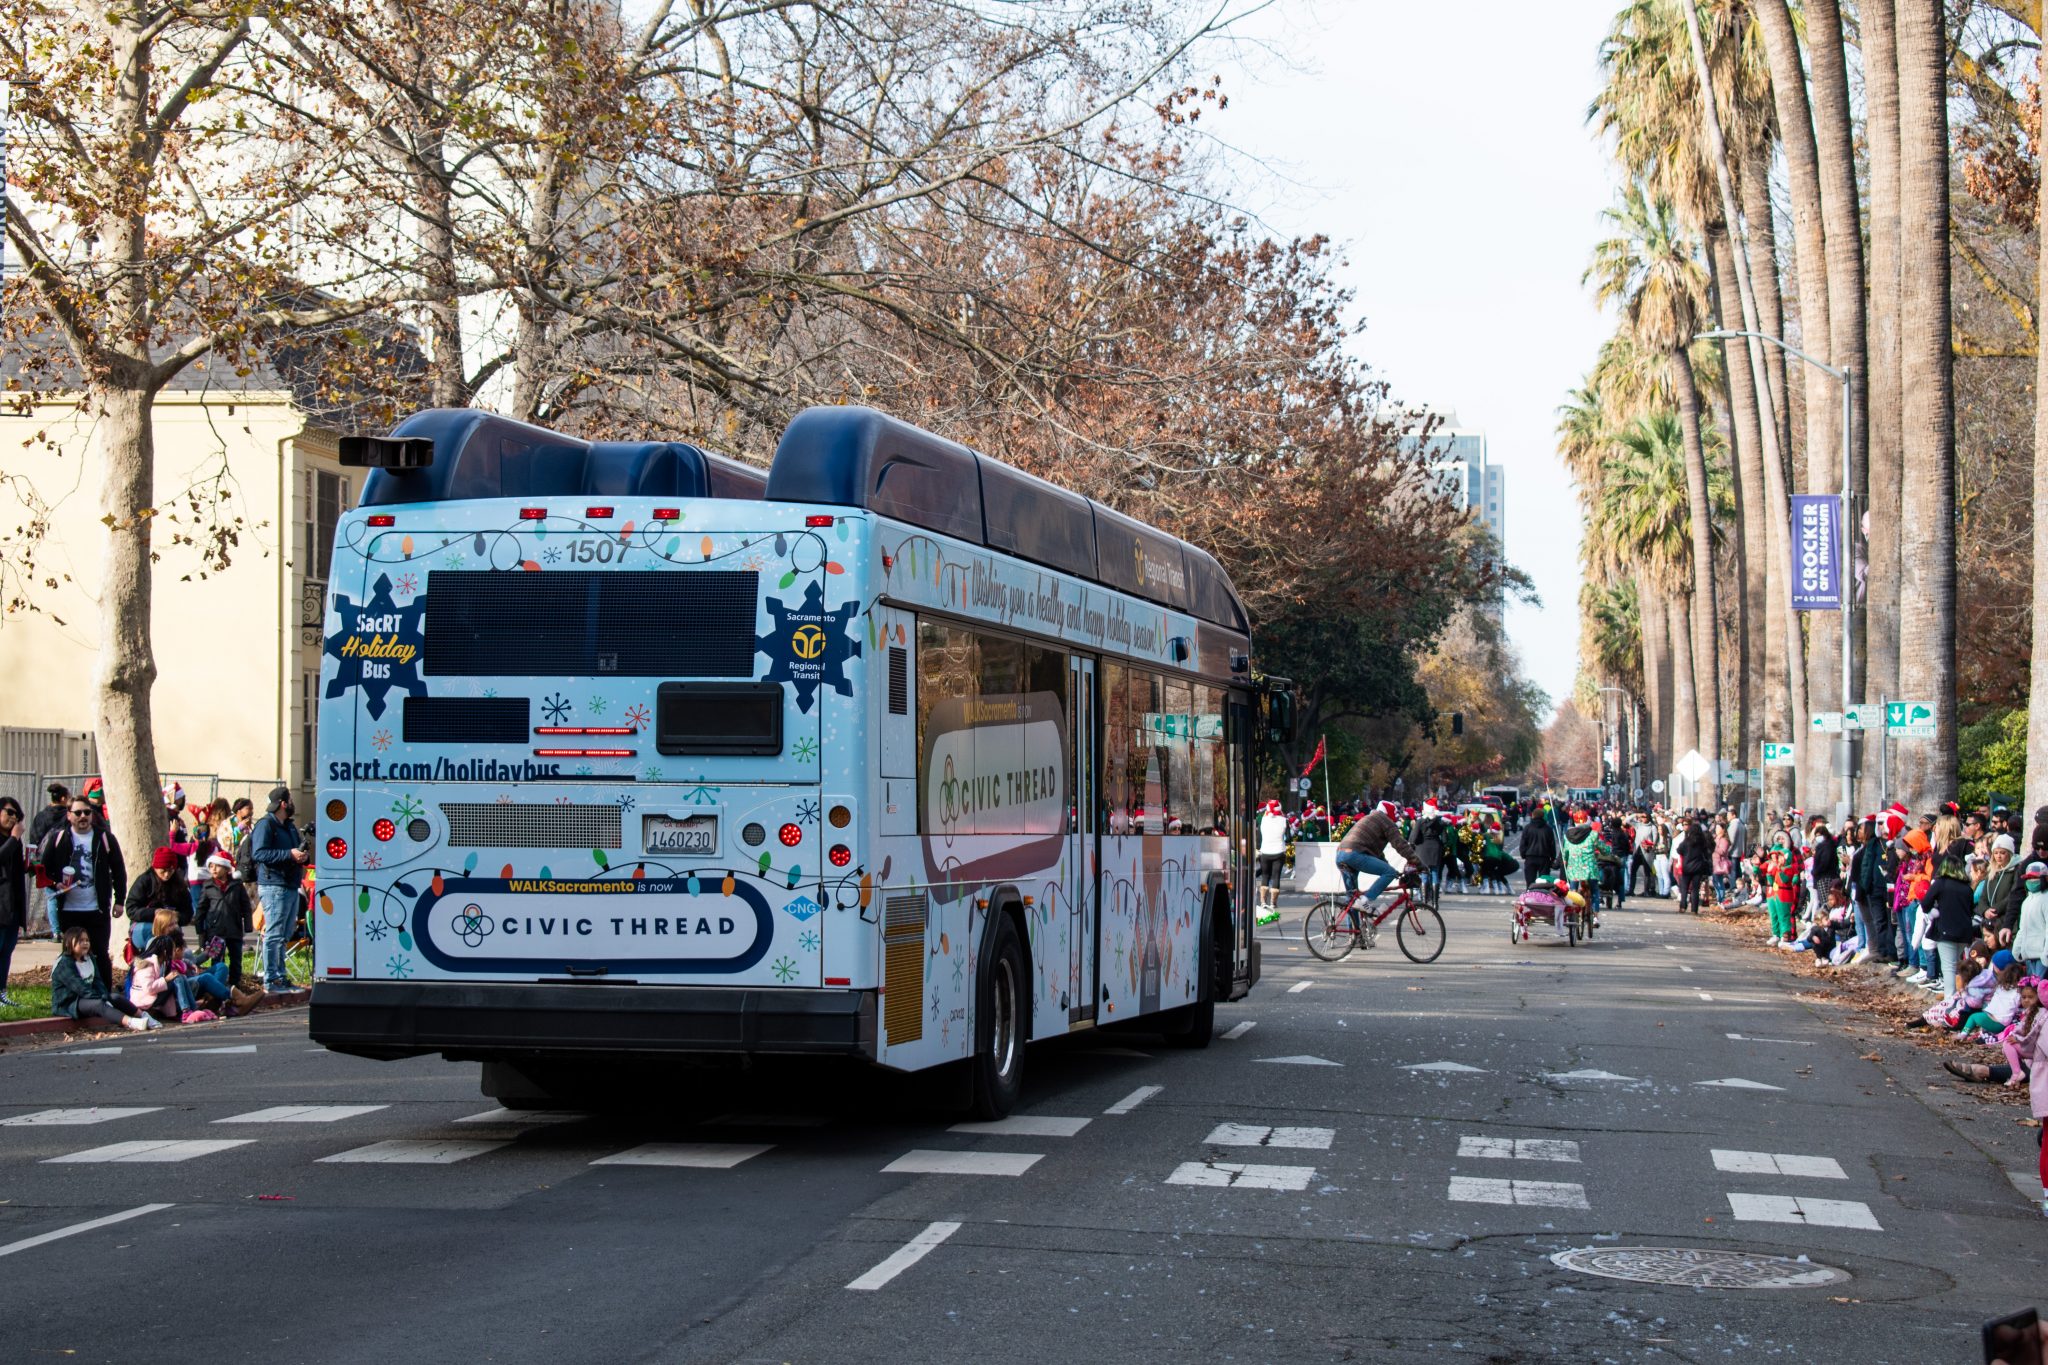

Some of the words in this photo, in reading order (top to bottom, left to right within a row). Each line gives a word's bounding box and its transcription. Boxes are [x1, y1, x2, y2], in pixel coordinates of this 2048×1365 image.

[1819, 503, 1829, 566] museum
[566, 539, 632, 564] 1507
[1802, 503, 1818, 592] CROCKER
[1144, 554, 1167, 586] Regional
[1819, 568, 1829, 592] art
[972, 556, 1007, 625] Wishing
[1009, 585, 1025, 626] you
[1028, 591, 1034, 618] a
[1036, 570, 1064, 638] healthy
[1067, 586, 1082, 632] and
[1083, 587, 1105, 649] happy
[1107, 592, 1131, 655] holiday
[356, 613, 403, 633] SacRT
[786, 612, 836, 622] Sacramento
[341, 633, 417, 665] Holiday
[362, 659, 391, 679] Bus
[789, 661, 826, 671] Regional
[792, 670, 821, 680] Transit
[329, 756, 561, 782] sacrt.com/holidaybus
[961, 774, 1000, 815] CIVIC
[1007, 766, 1056, 806] THREAD
[652, 830, 710, 848] 1460230
[508, 880, 635, 893] WALKSacramento
[637, 881, 646, 892] is
[649, 882, 674, 892] now
[787, 902, 817, 915] CNG
[502, 917, 593, 936] CIVIC
[610, 917, 735, 936] THREAD
